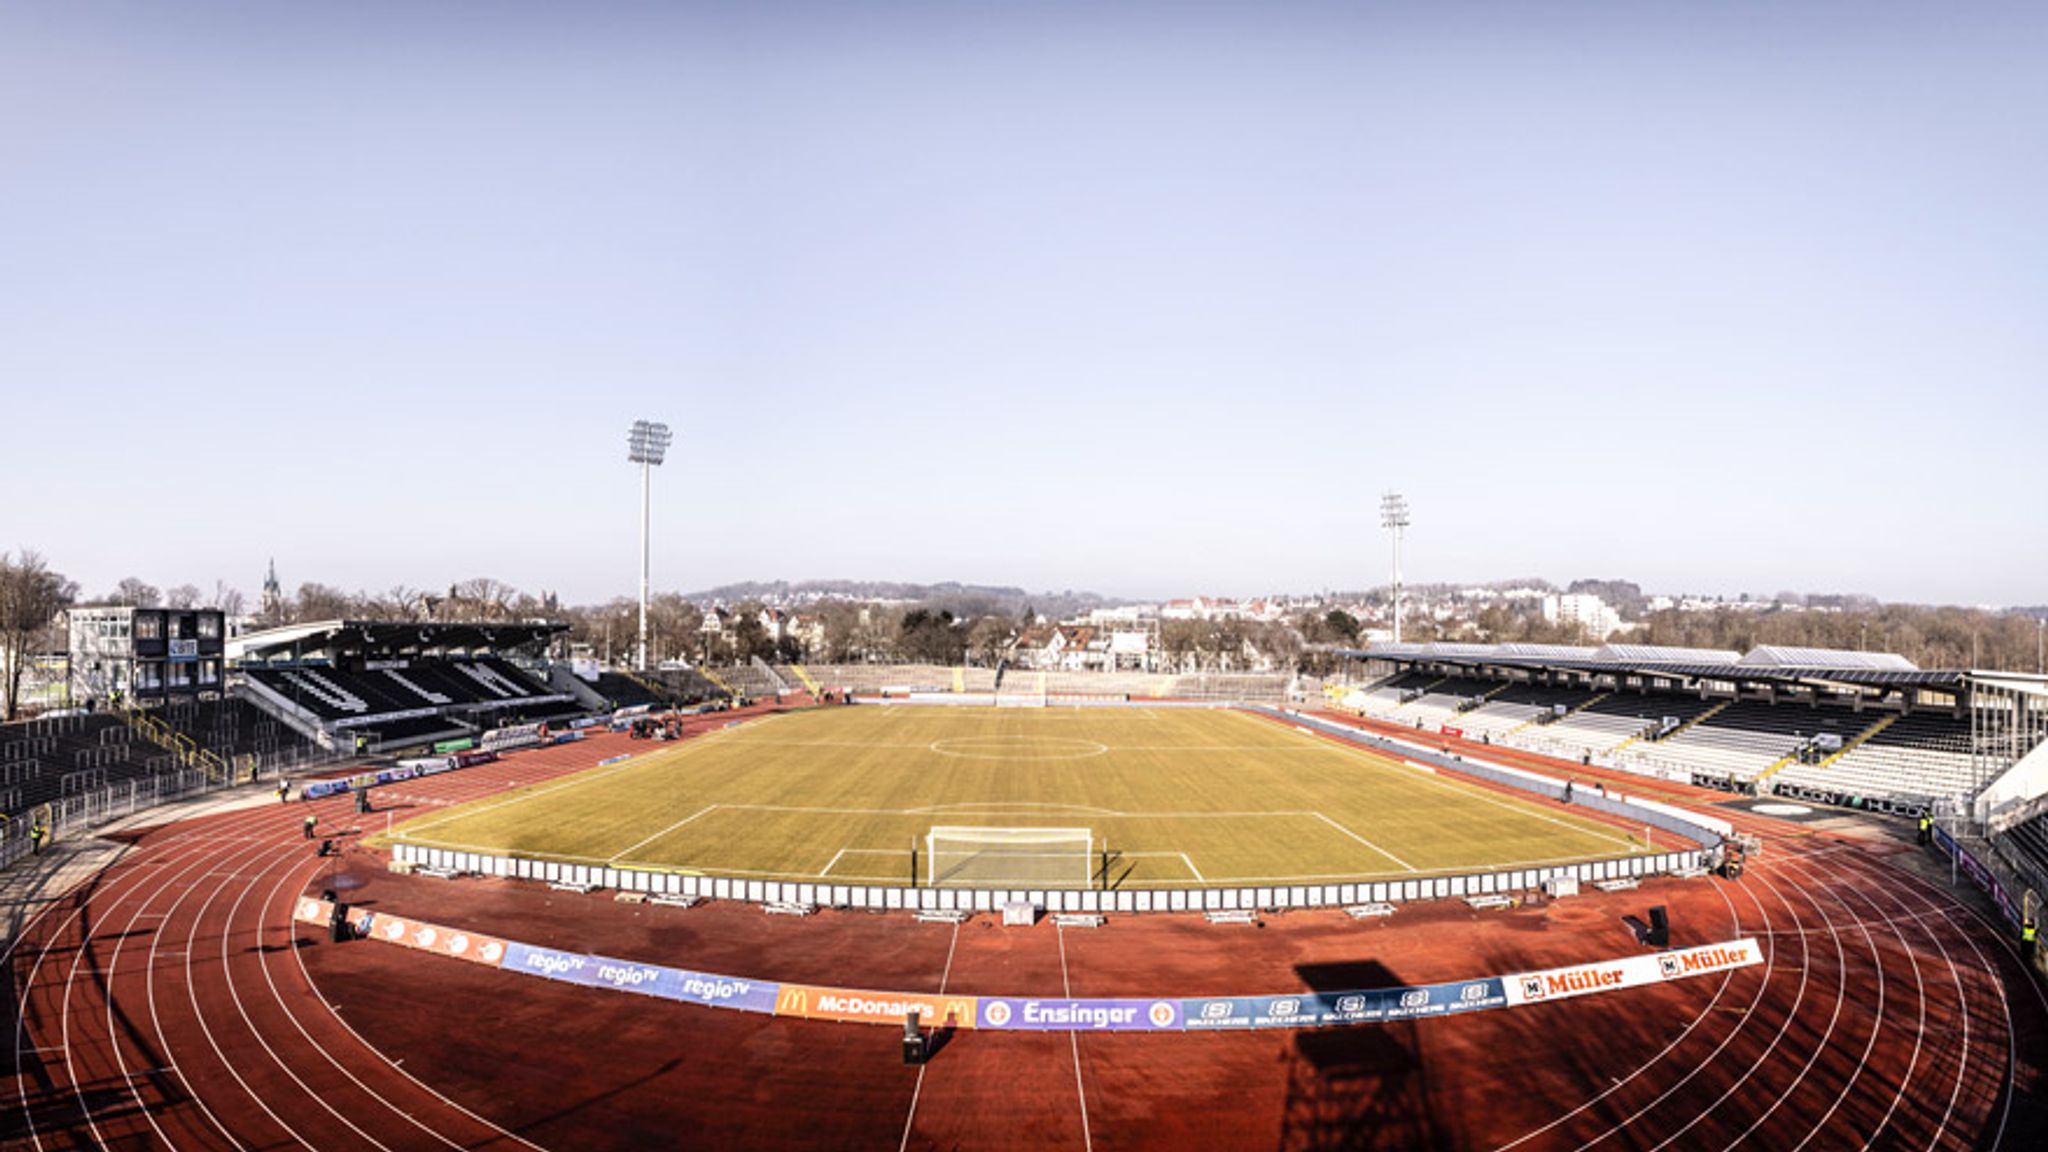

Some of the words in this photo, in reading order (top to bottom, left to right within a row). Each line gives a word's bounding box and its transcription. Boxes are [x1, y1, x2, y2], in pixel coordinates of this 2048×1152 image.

[1681, 948, 1748, 971] Müller
[1547, 969, 1624, 994] Müller
[1023, 1001, 1137, 1028] Ensinger
